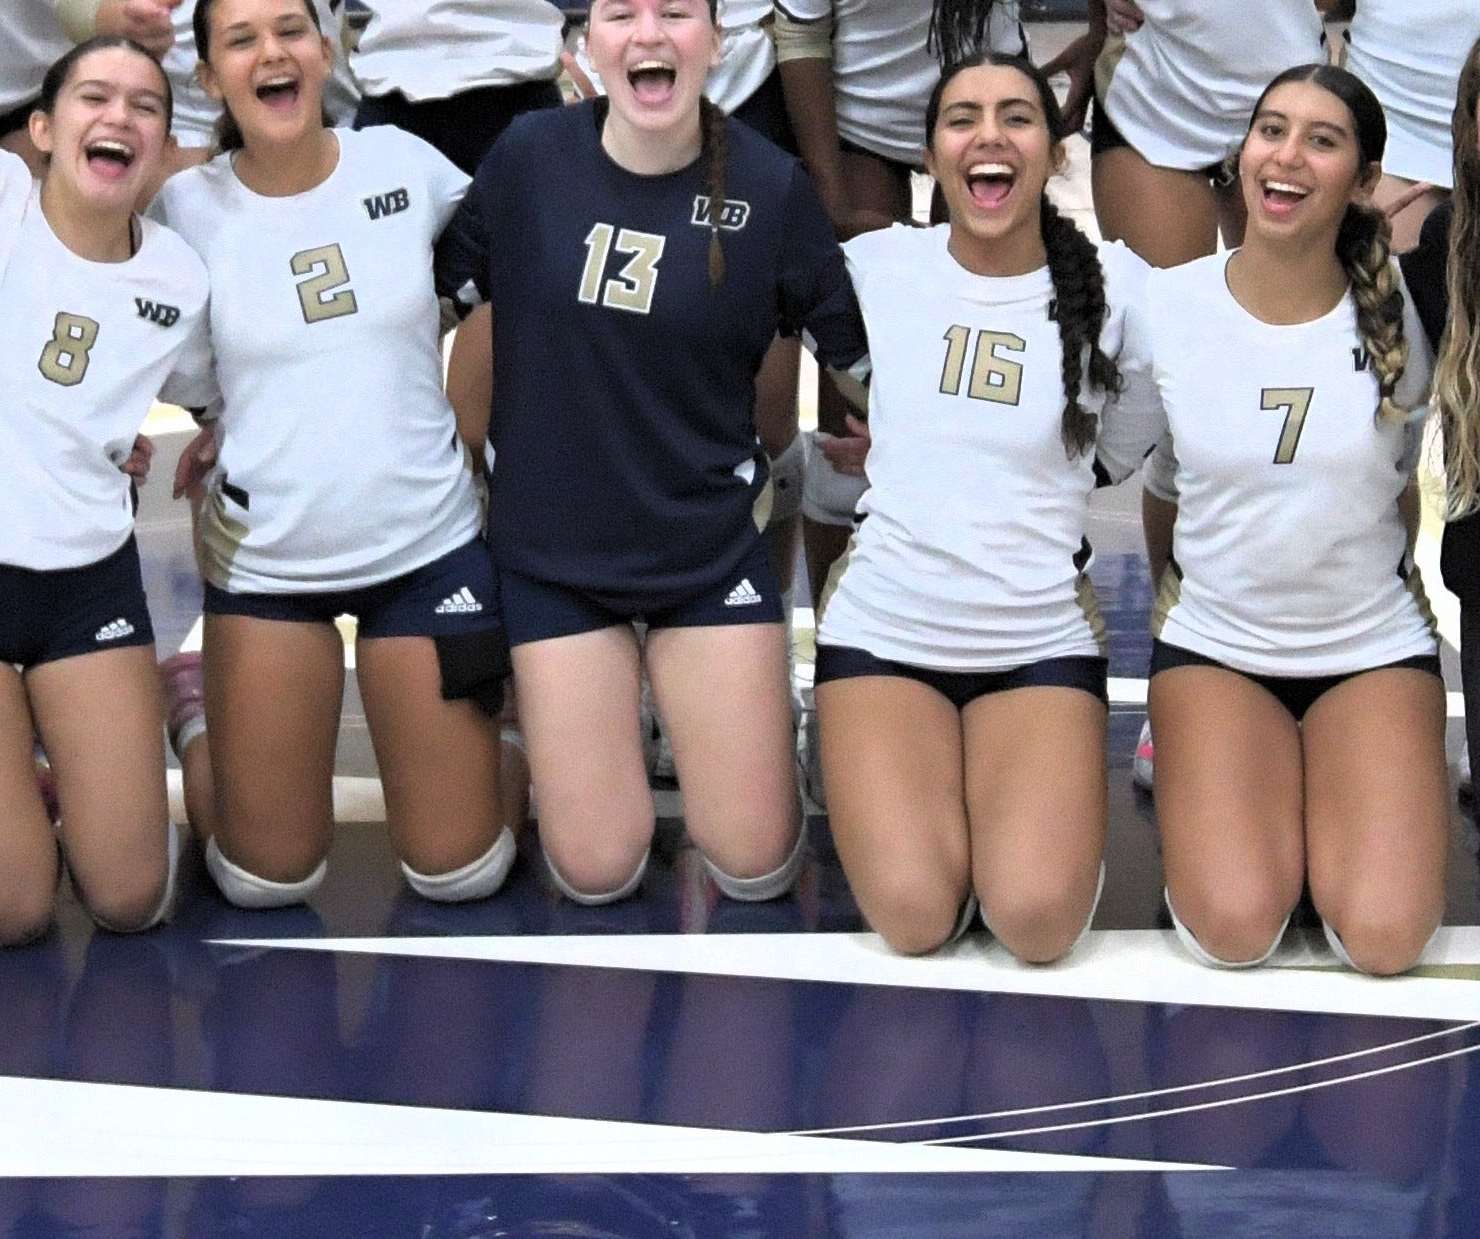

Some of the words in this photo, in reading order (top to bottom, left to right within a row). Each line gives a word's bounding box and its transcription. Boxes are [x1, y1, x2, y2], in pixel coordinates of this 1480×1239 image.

[363, 187, 412, 221] WB
[290, 242, 359, 324] 2
[578, 222, 667, 315] 13
[38, 311, 100, 388] 8
[134, 296, 182, 329] WB
[938, 324, 1027, 407] 16
[1260, 387, 1315, 465] 7
